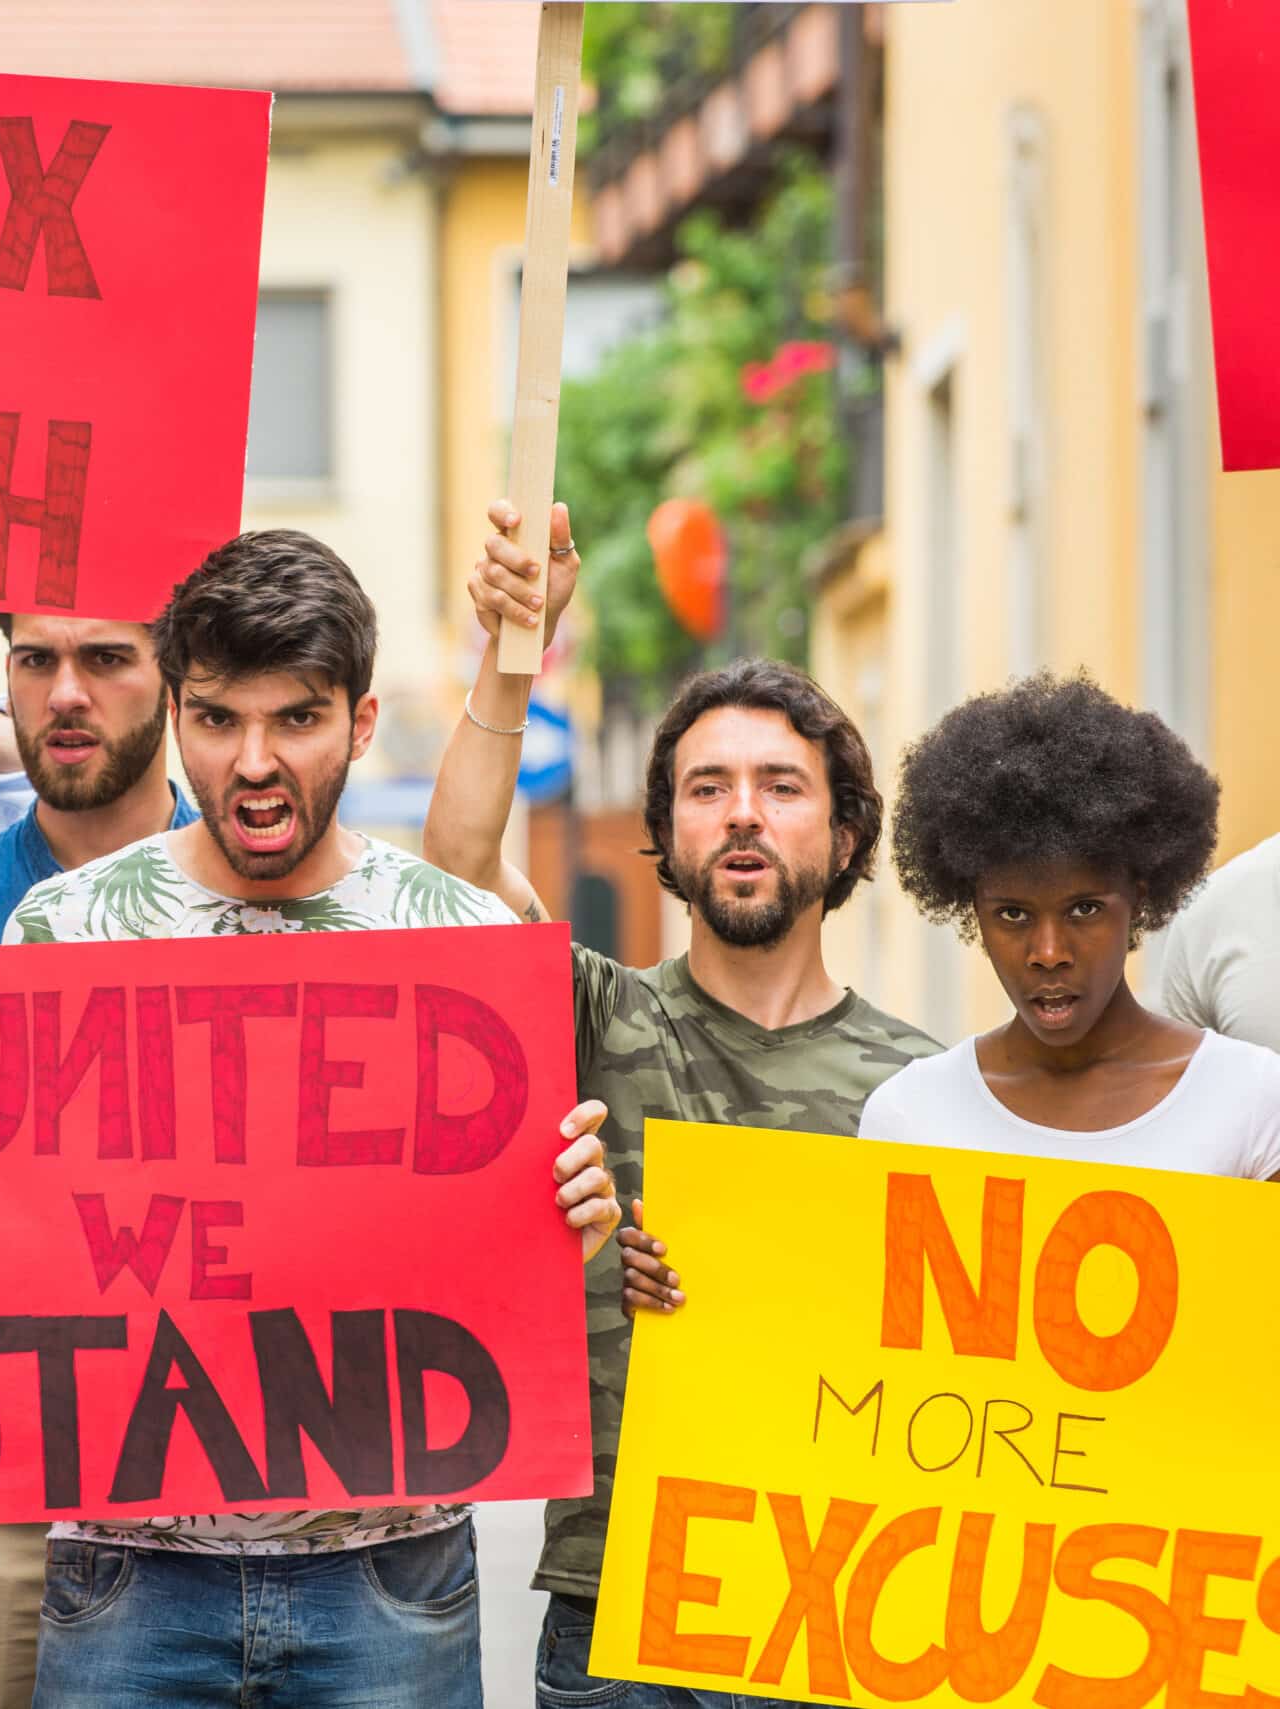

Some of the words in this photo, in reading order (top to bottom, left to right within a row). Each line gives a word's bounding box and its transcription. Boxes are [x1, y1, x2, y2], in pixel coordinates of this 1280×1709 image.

[71, 1191, 254, 1302] WE
[879, 1171, 1180, 1393] NO
[812, 1373, 1109, 1494] MORE
[638, 1475, 1280, 1709] EXCUSE
